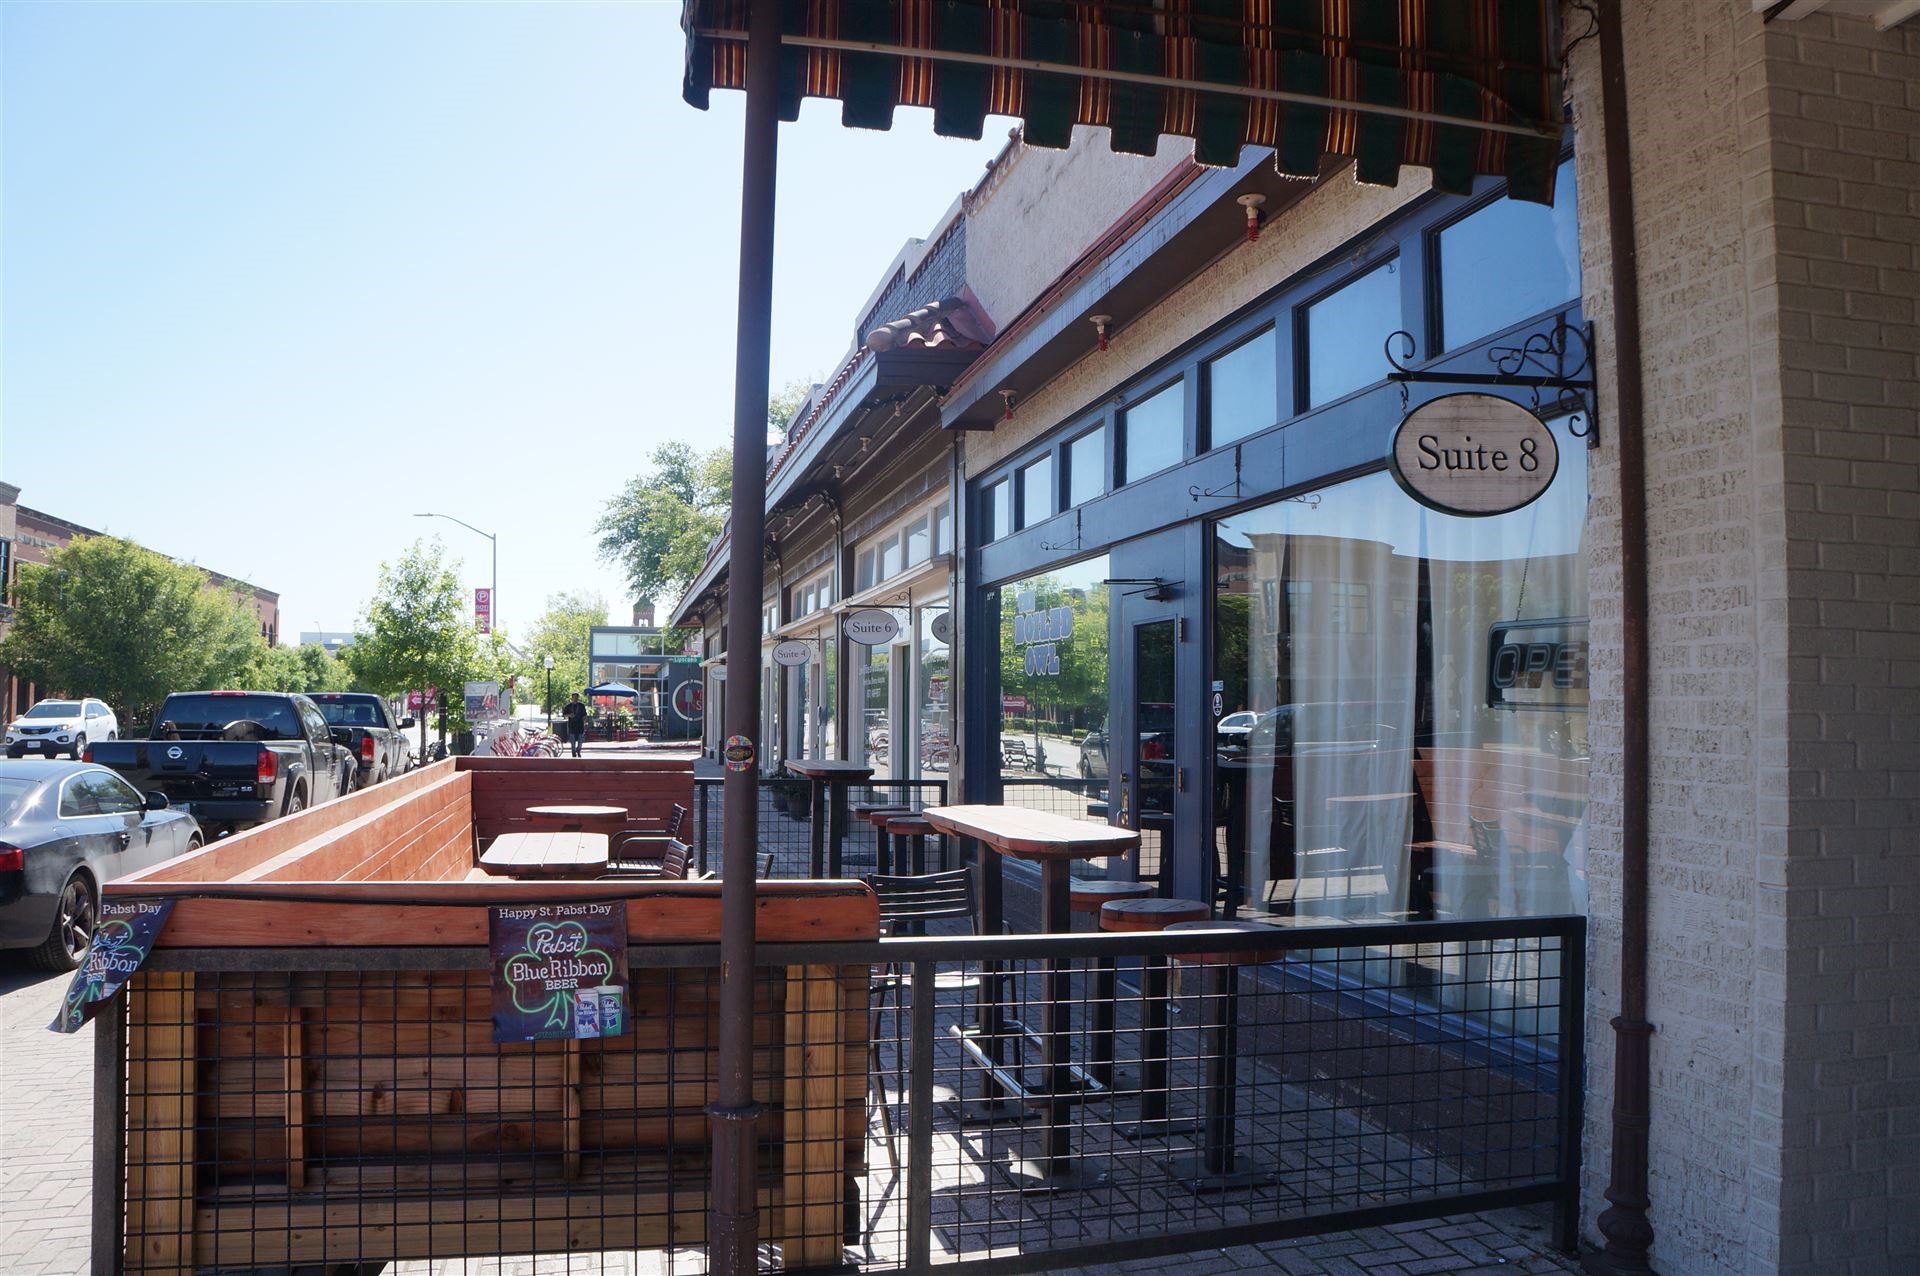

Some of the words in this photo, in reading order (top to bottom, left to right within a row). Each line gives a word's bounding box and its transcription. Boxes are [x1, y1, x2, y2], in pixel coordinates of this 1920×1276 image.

[1417, 434, 1509, 471] Suite
[1519, 437, 1539, 472] 8
[852, 621, 882, 633] Suite
[884, 621, 892, 633] 6
[777, 649, 800, 658] Suite
[1024, 643, 1060, 677] OWL
[1492, 642, 1587, 689] OPE
[102, 904, 136, 915] Pabst
[138, 903, 162, 915] Day
[498, 908, 537, 920] Happy
[539, 906, 554, 917] St.
[556, 905, 588, 916] Pabst
[589, 904, 612, 916] Day
[534, 928, 583, 954] Pabst
[89, 951, 138, 972] Ribbon
[512, 962, 549, 982] Blue
[549, 957, 608, 978] Ribbon
[544, 978, 579, 991] BEER
